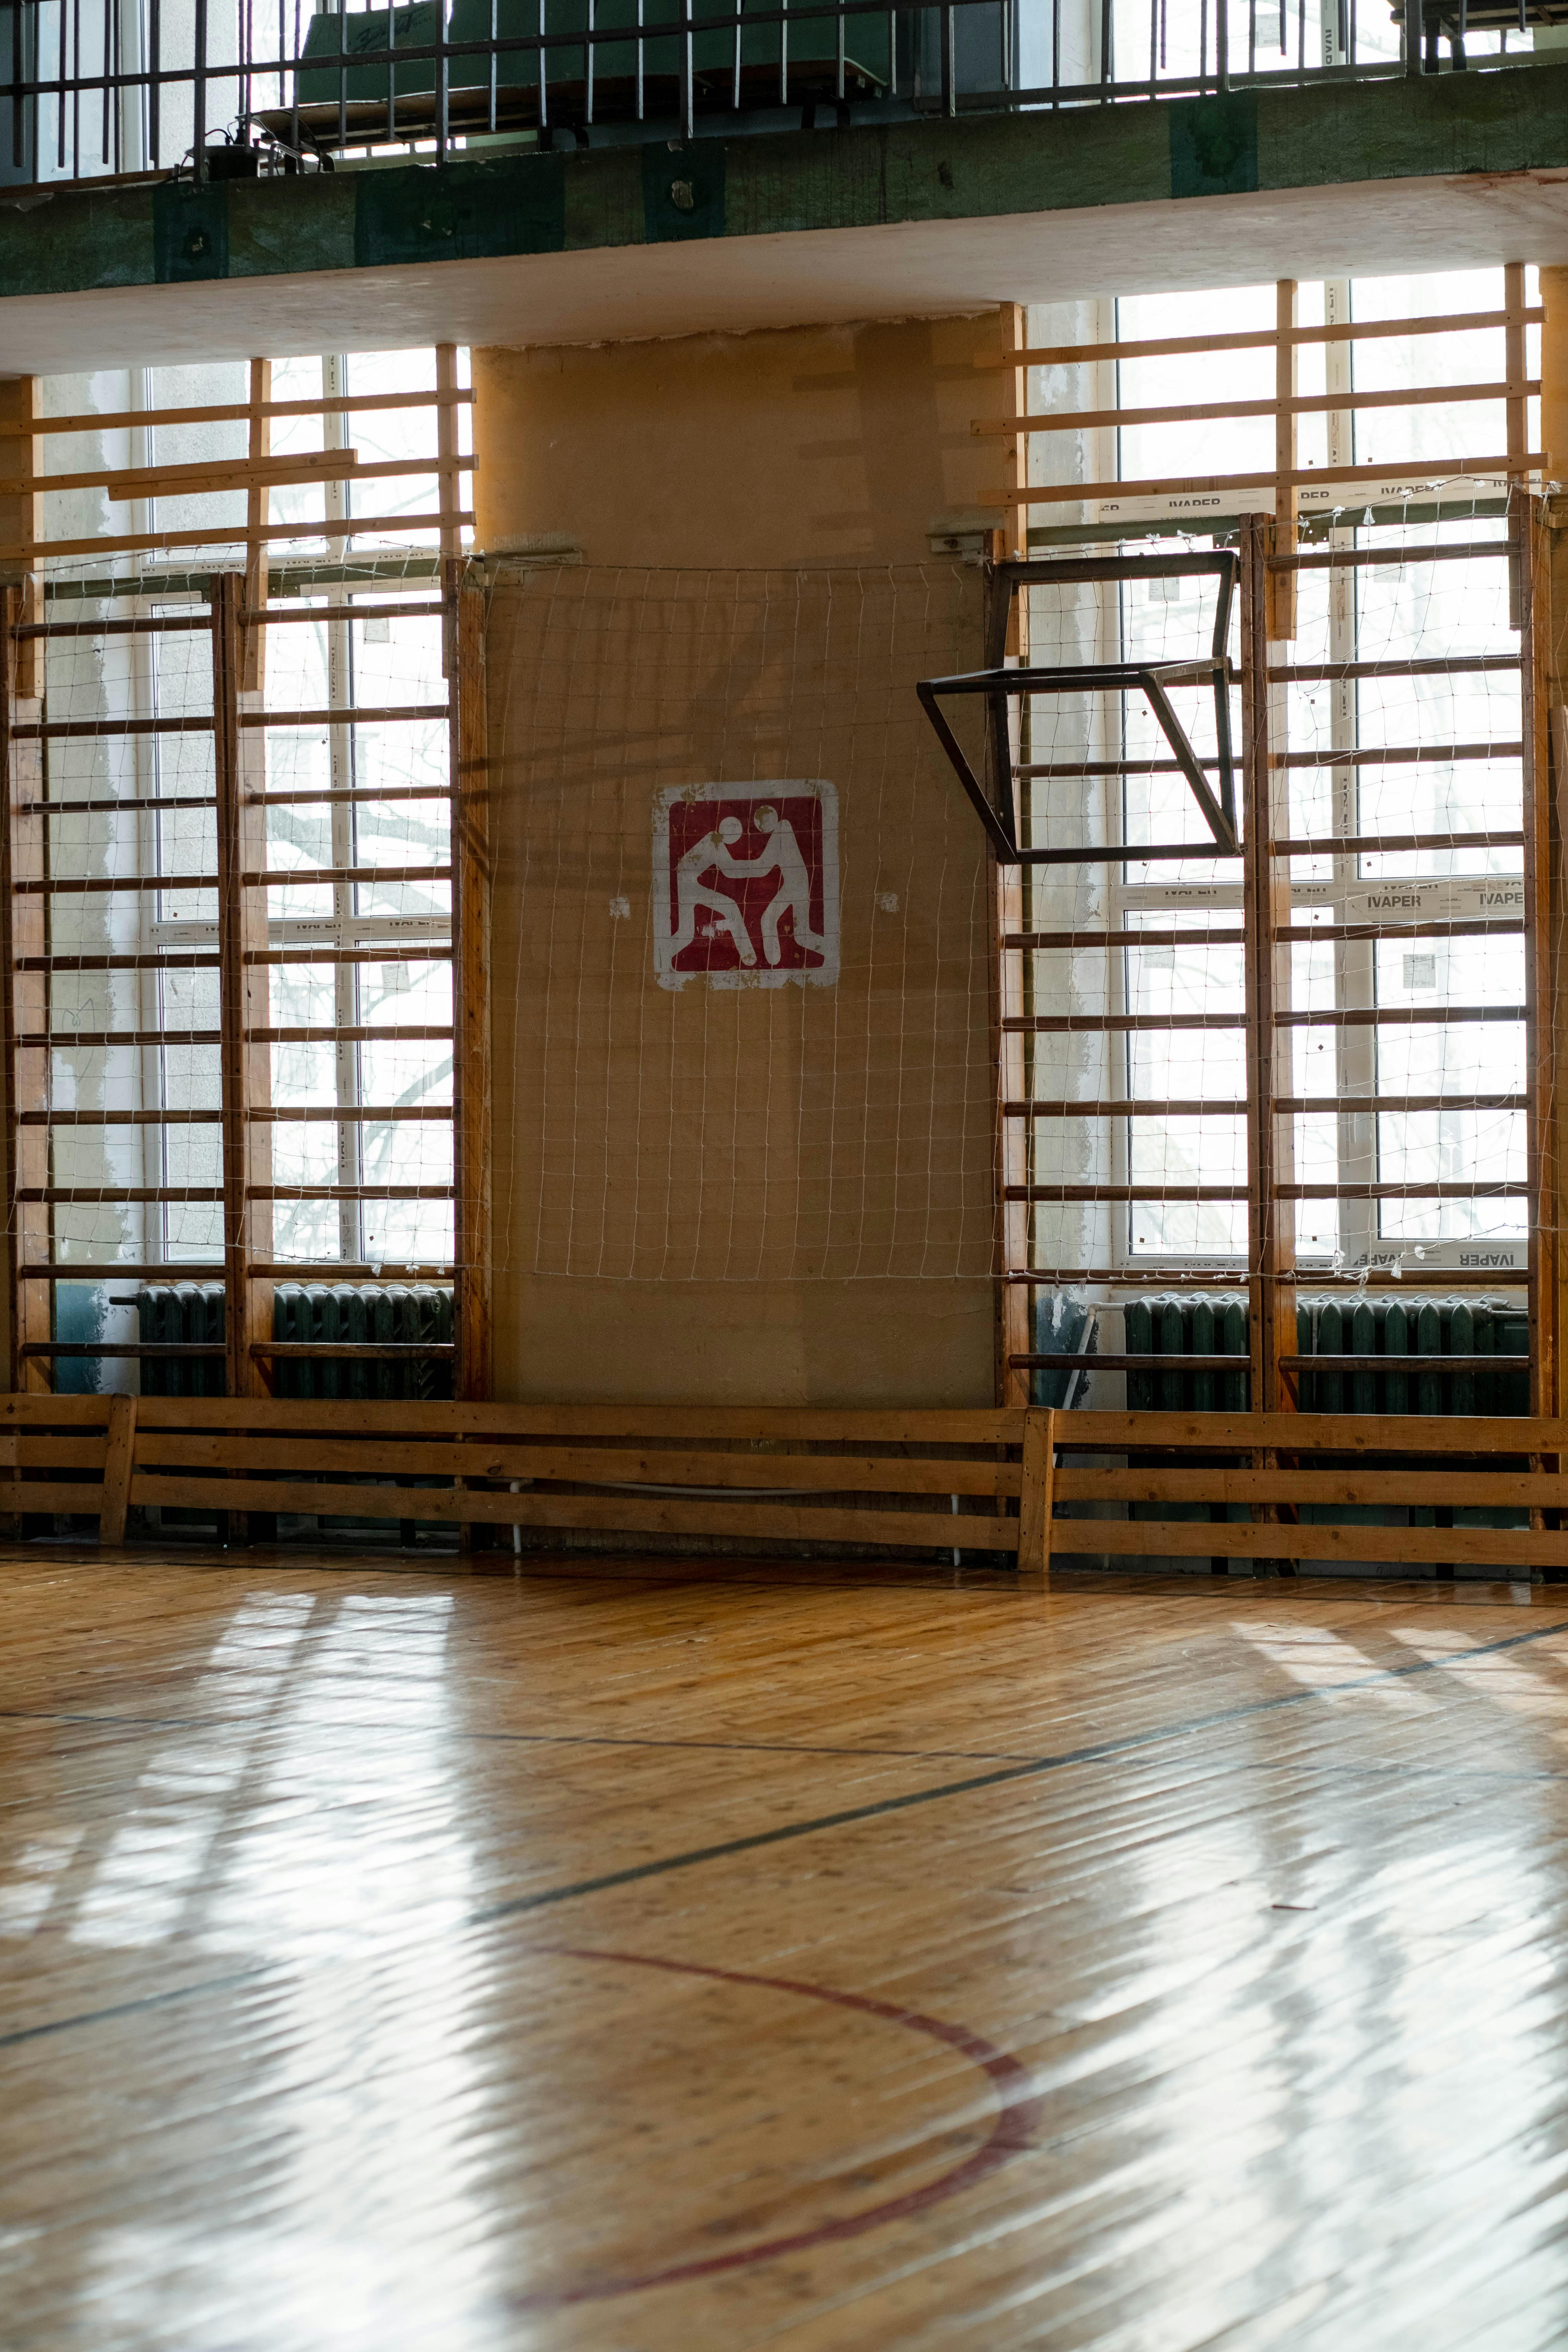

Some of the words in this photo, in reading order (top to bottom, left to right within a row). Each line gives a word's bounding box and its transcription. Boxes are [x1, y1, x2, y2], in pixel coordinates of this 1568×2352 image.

[1368, 895, 1421, 908] IVAPER
[1480, 893, 1523, 905] IVAPE
[1352, 1254, 1401, 1266] VAPE
[1460, 1254, 1514, 1266] IVAPER
